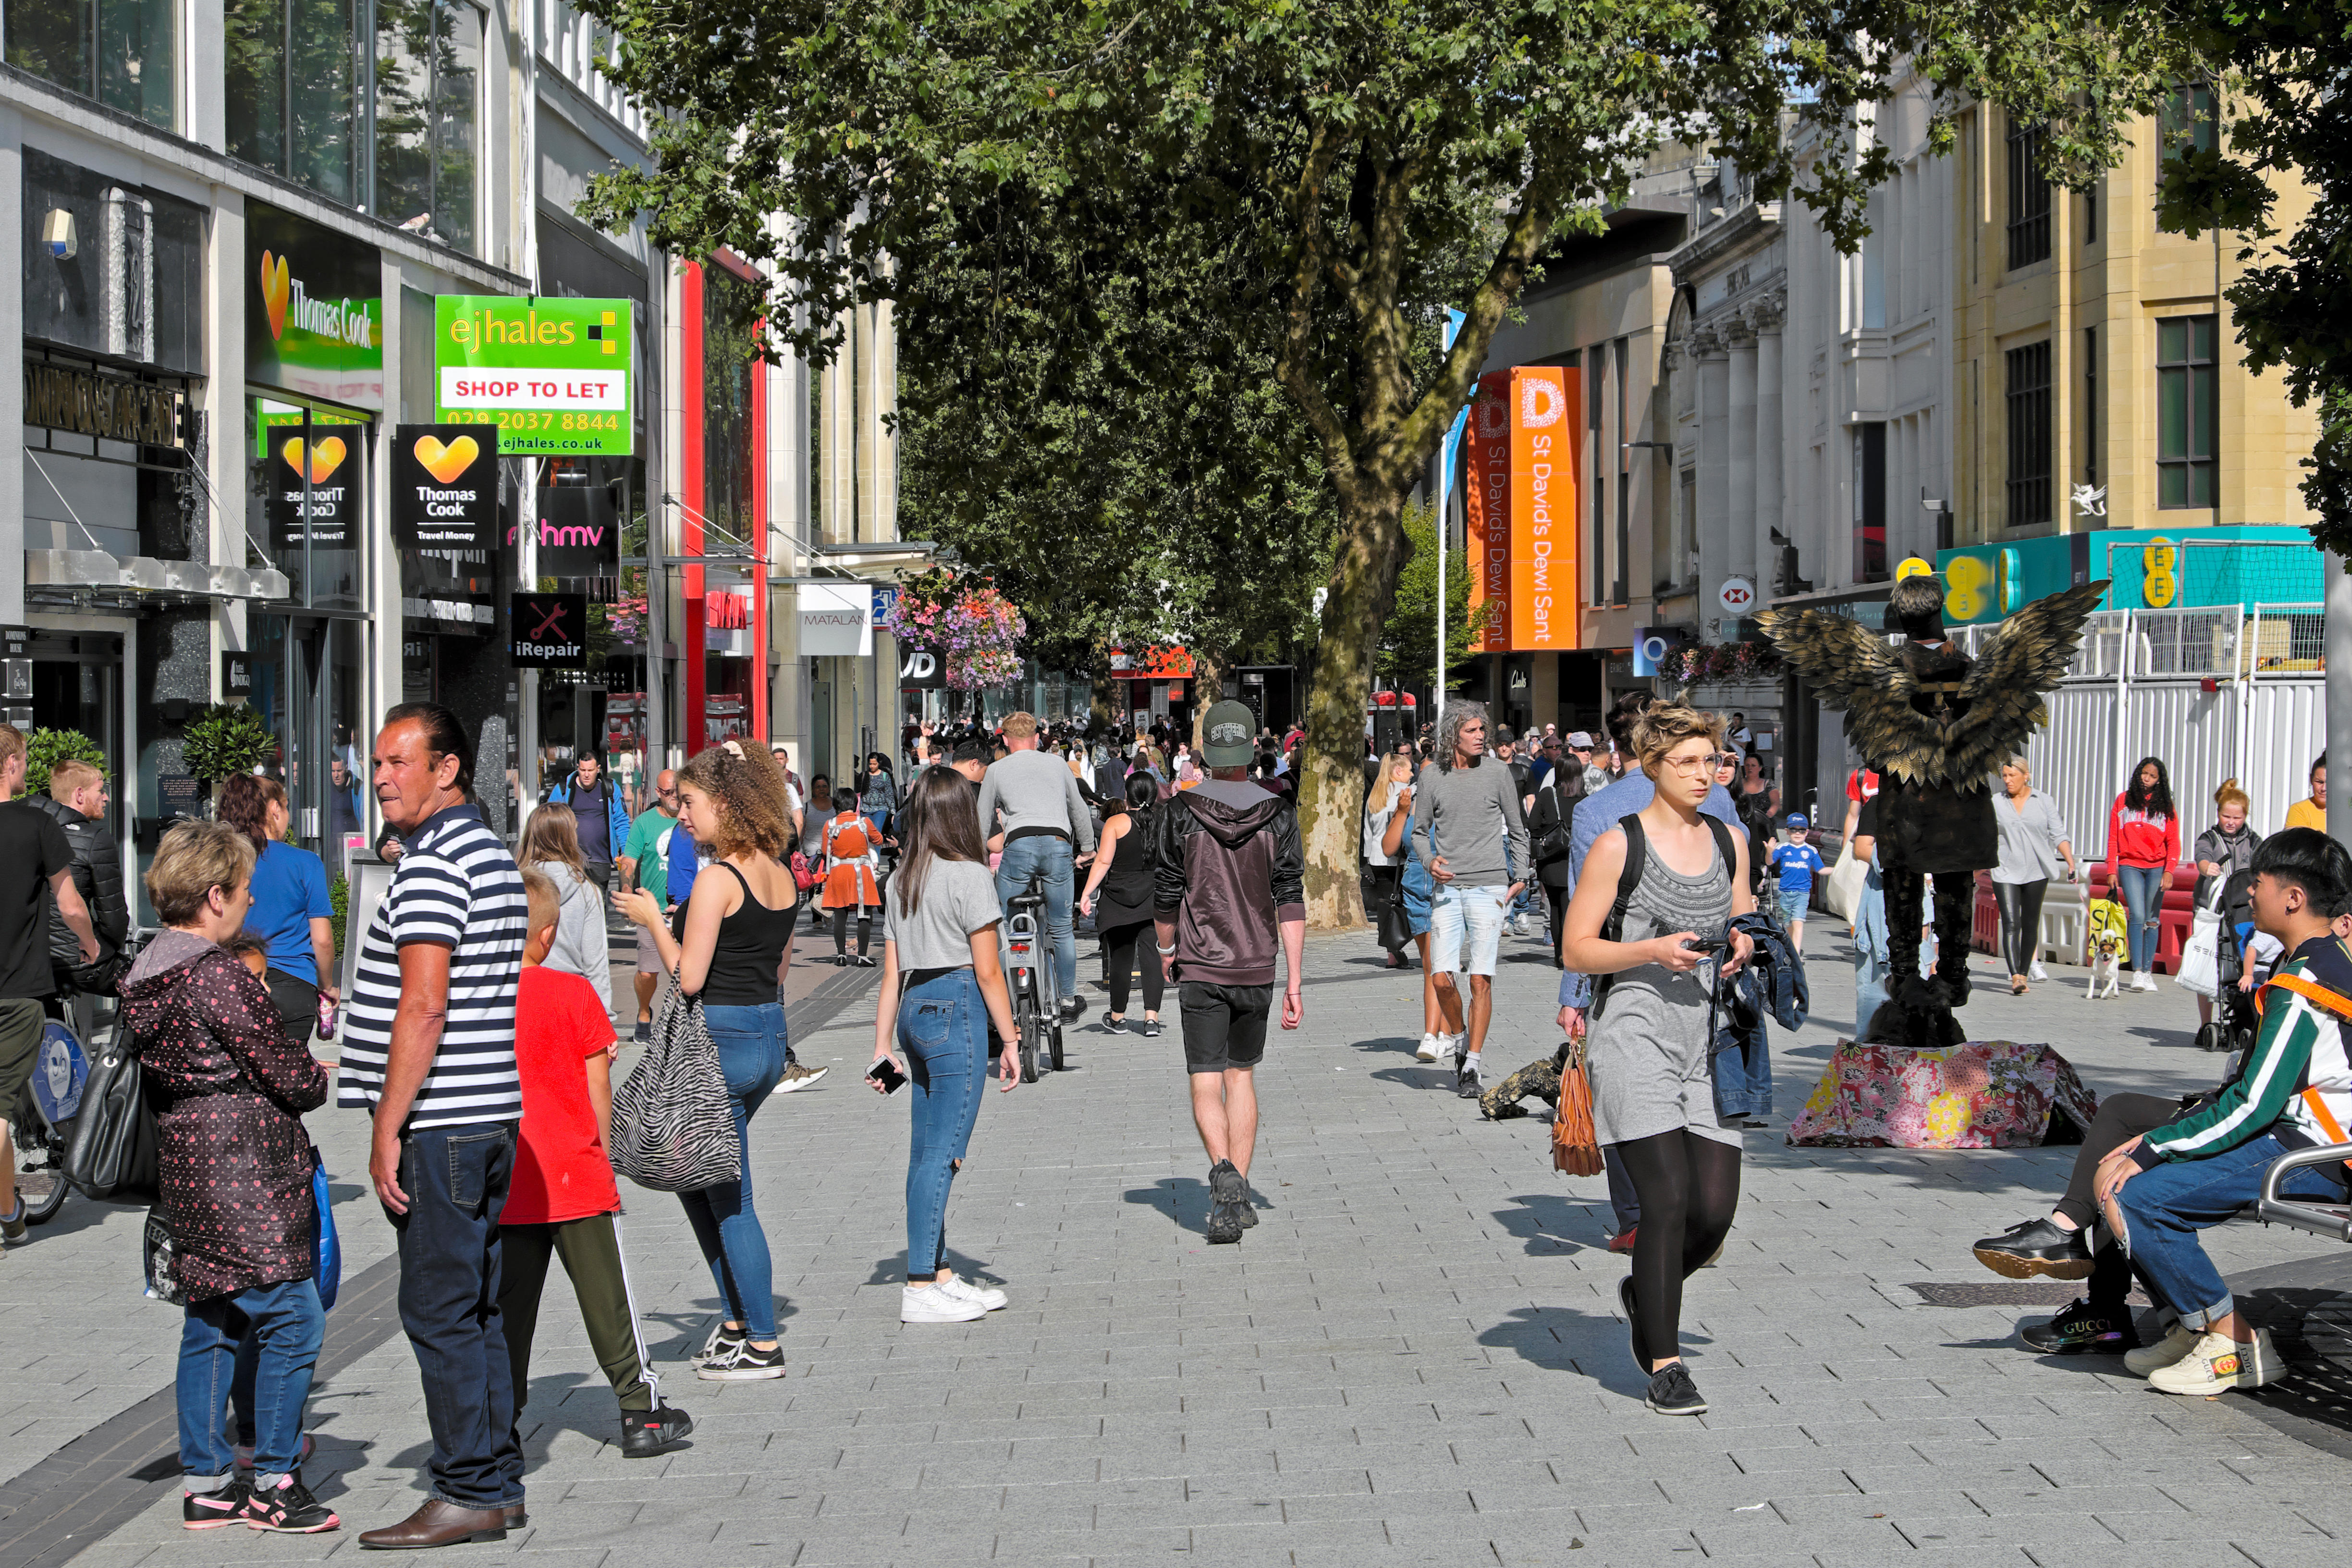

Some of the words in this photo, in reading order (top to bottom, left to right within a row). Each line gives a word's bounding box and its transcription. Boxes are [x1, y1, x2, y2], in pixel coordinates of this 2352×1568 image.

[291, 278, 340, 340] Thomas
[342, 297, 372, 349] Cook
[450, 309, 576, 354] ejhales
[455, 381, 519, 397] SHOP
[528, 382, 557, 398] TO
[567, 382, 609, 399] LET
[498, 412, 554, 430] 2037
[561, 413, 619, 431] 8844
[1489, 446, 1506, 466] St
[1532, 435, 1552, 457] St
[416, 486, 477, 501] Thomas
[1532, 464, 1552, 536] David's
[426, 502, 465, 516] Cook
[1489, 473, 1506, 542] David's
[417, 531, 444, 540] Travel
[445, 531, 475, 542] Money
[541, 518, 604, 546] hmv
[1490, 548, 1506, 597] Dewi
[1534, 541, 1552, 591] Dewi
[804, 615, 868, 625] MATALAN
[1490, 599, 1506, 644] Sant
[1533, 596, 1552, 642] Sant
[5, 630, 26, 641] DOMINIONS
[10, 643, 22, 653] HOUSE
[516, 642, 581, 660] iRepair
[900, 652, 936, 678] JD
[1211, 723, 1247, 742] SLYTHERIN
[2064, 1319, 2112, 1334] GUCCI
[2202, 1359, 2215, 1383] GUCCI
[2240, 1348, 2254, 1373] GUCCI
